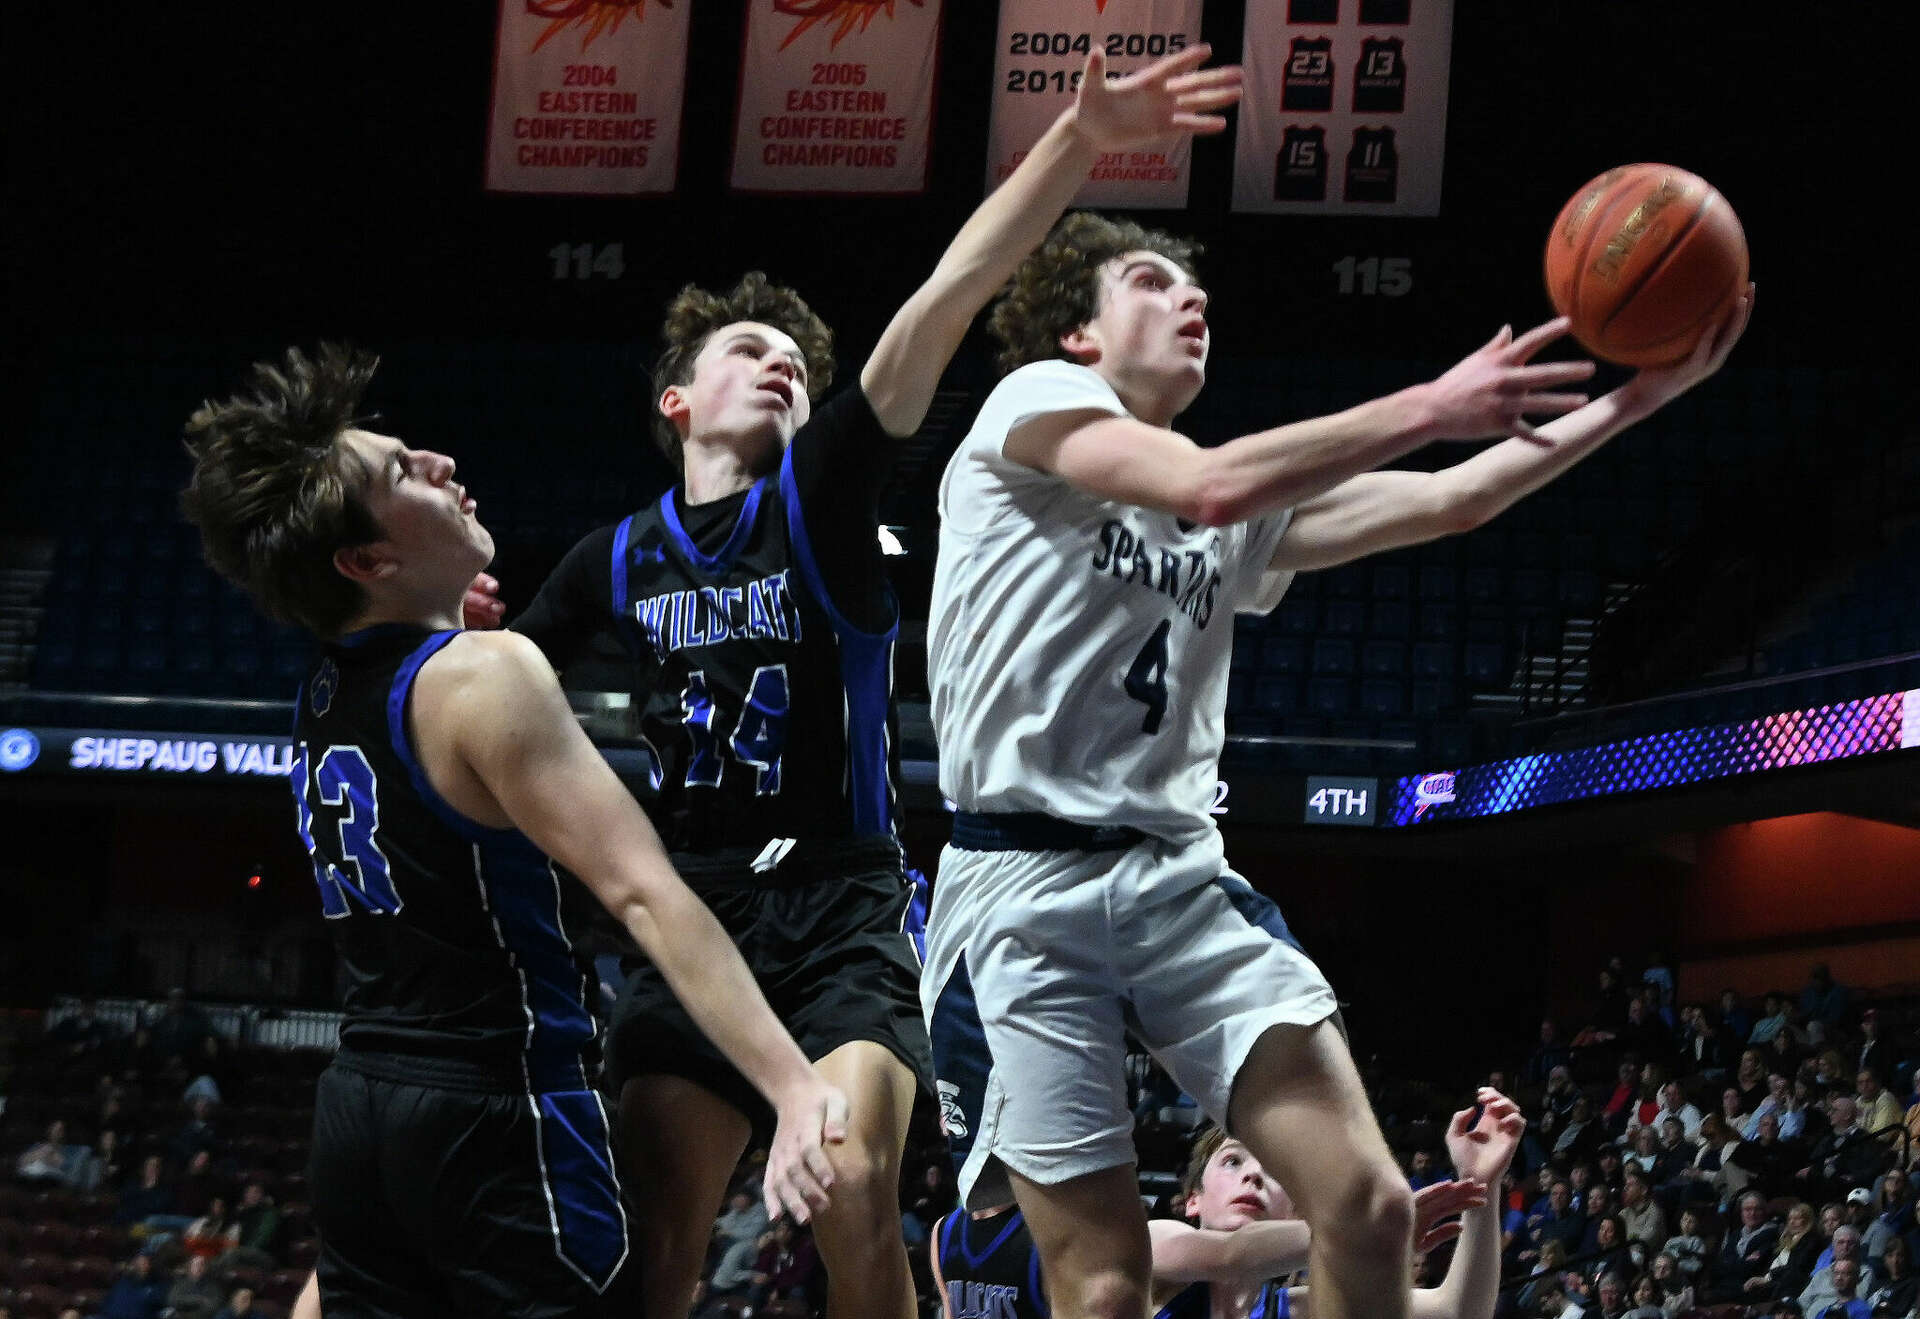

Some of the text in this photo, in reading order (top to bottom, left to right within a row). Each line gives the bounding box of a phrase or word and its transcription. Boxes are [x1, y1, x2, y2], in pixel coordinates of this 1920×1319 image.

[1010, 32, 1186, 57] 2004 2005
[811, 63, 867, 86] 2005
[1290, 50, 1329, 75] 23
[1366, 50, 1396, 76] 13
[563, 65, 617, 86] 2004
[539, 91, 638, 113] EASTERN
[786, 89, 886, 112] EASTERN
[514, 117, 656, 140] CONFERENCE
[760, 117, 906, 140] CONFERENCE
[518, 145, 649, 168] CHAMPIONS
[763, 144, 897, 168] CHAMPIONS
[1130, 152, 1166, 167] SUN
[1288, 140, 1317, 167] 15
[1362, 140, 1383, 168] 11
[549, 242, 626, 280] 114
[1332, 256, 1412, 296] 115
[1124, 619, 1171, 736] 4
[681, 663, 790, 797] 14
[70, 737, 217, 772] SHEPAUG
[1309, 788, 1368, 816] 4TH
